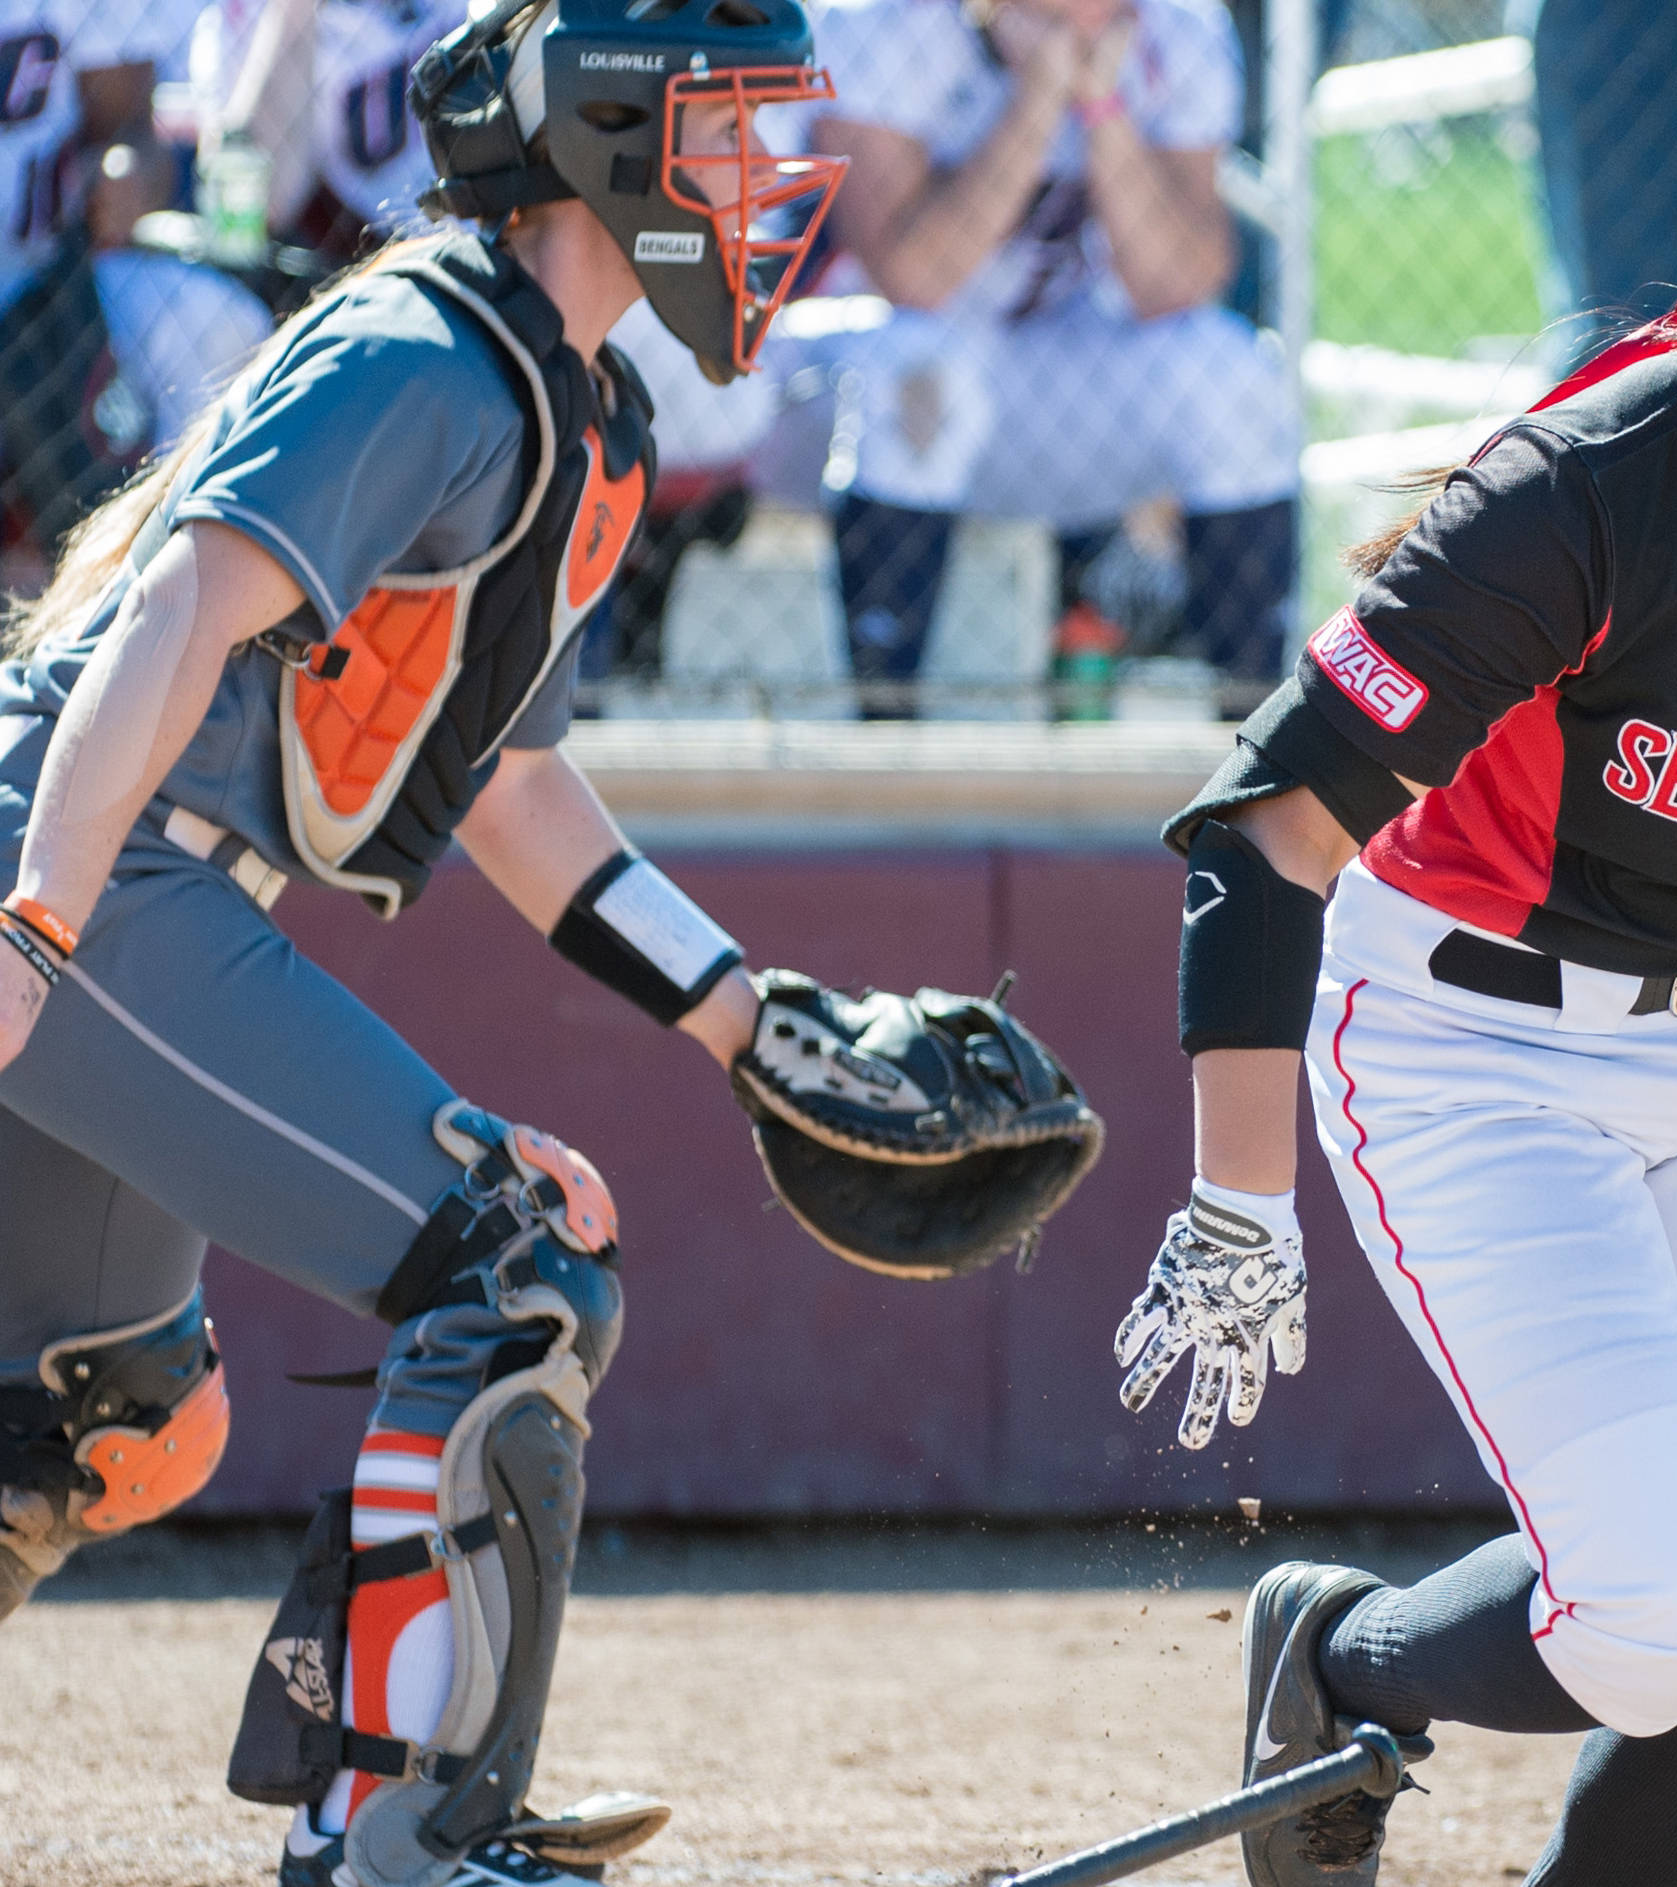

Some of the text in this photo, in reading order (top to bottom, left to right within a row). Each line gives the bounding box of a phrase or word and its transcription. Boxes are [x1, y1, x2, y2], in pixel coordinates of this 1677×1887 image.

[580, 51, 665, 73] LOUISVILLE
[640, 239, 698, 257] BENGALS
[1319, 617, 1417, 718] WAC
